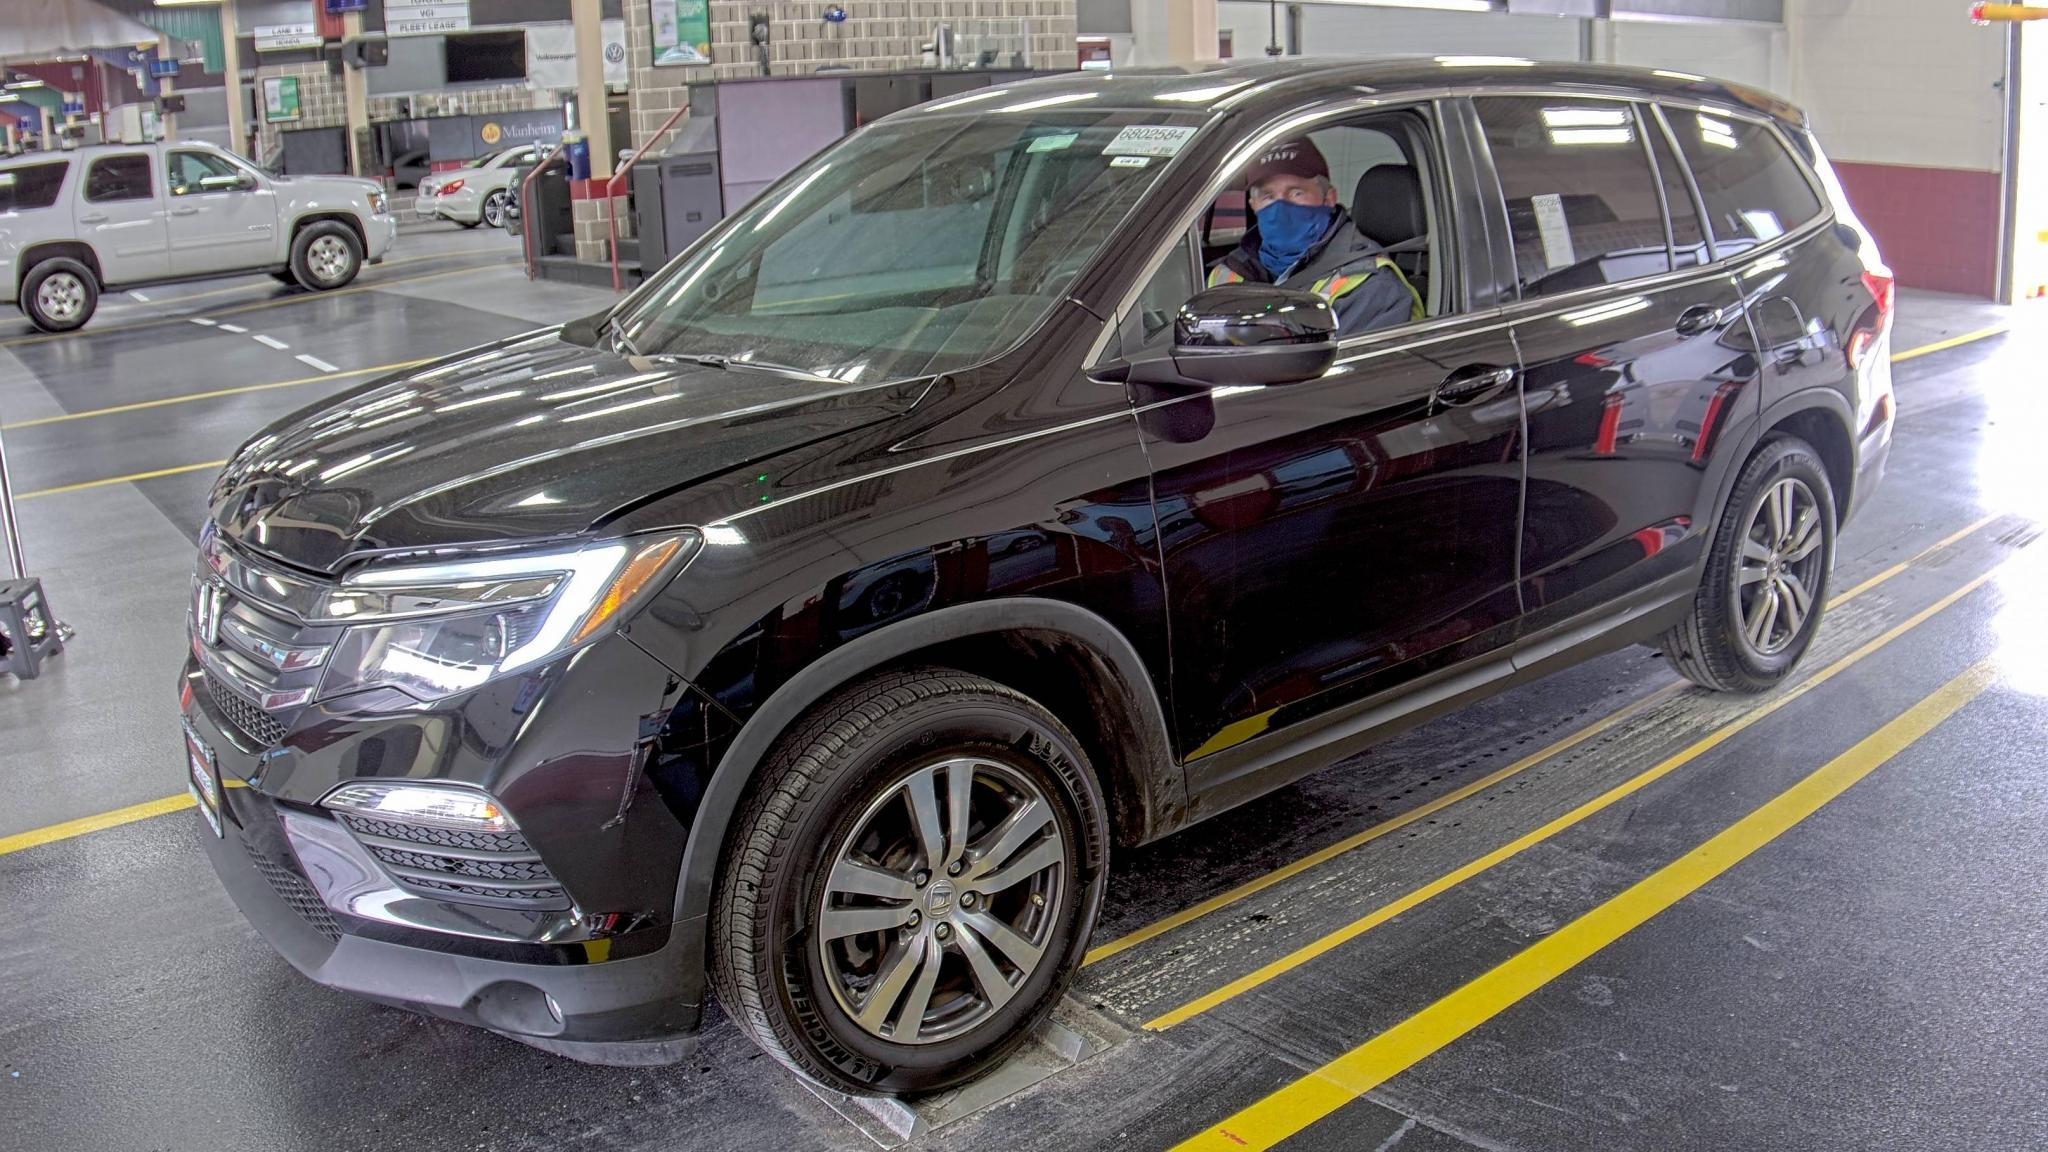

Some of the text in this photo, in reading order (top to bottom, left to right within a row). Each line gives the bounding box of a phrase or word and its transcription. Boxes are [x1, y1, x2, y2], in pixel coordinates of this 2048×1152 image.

[400, 20, 457, 32] FLEET LEASE
[502, 122, 555, 137] Manheim
[1119, 127, 1185, 140] 6802584
